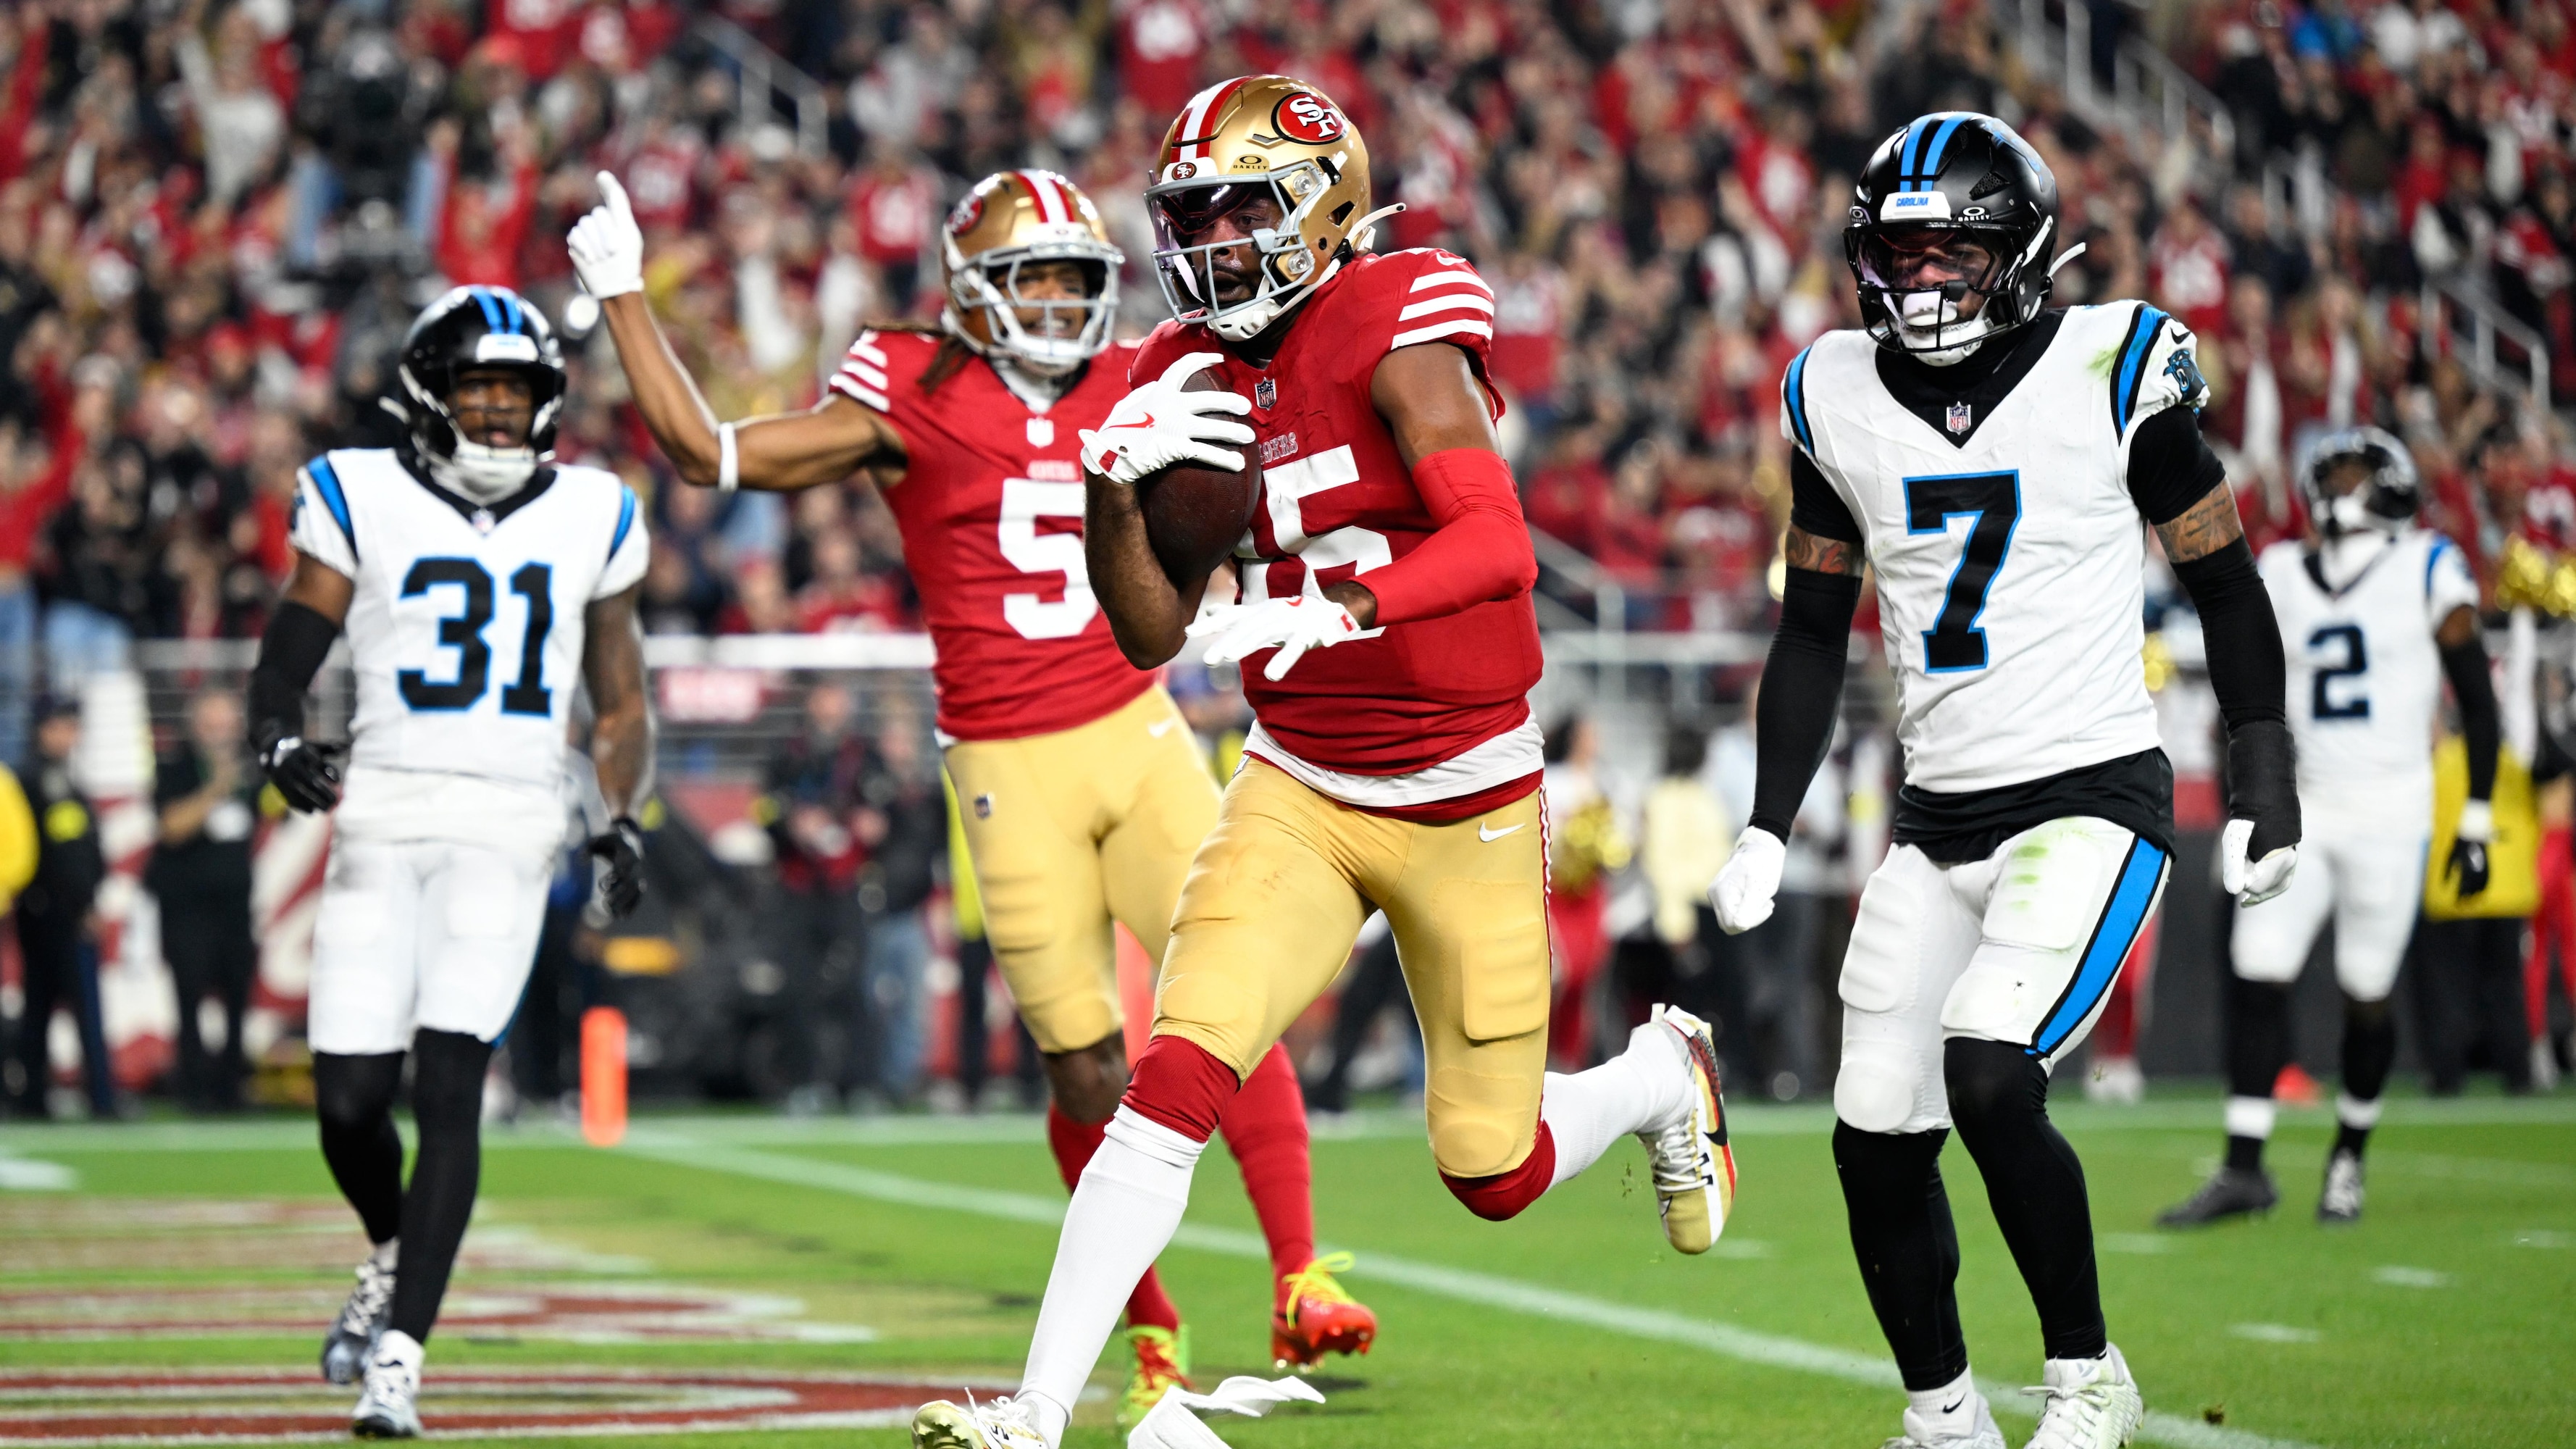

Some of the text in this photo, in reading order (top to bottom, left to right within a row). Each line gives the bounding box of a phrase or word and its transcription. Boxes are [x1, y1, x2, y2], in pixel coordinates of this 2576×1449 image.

[1896, 197, 1928, 207] CAROLINA
[1258, 432, 1299, 464] 9ERS
[1949, 416, 1967, 429] NFL
[998, 477, 1098, 640] 5
[1902, 469, 2022, 674] 7
[398, 556, 556, 718] 31
[2307, 622, 2370, 720] 2
